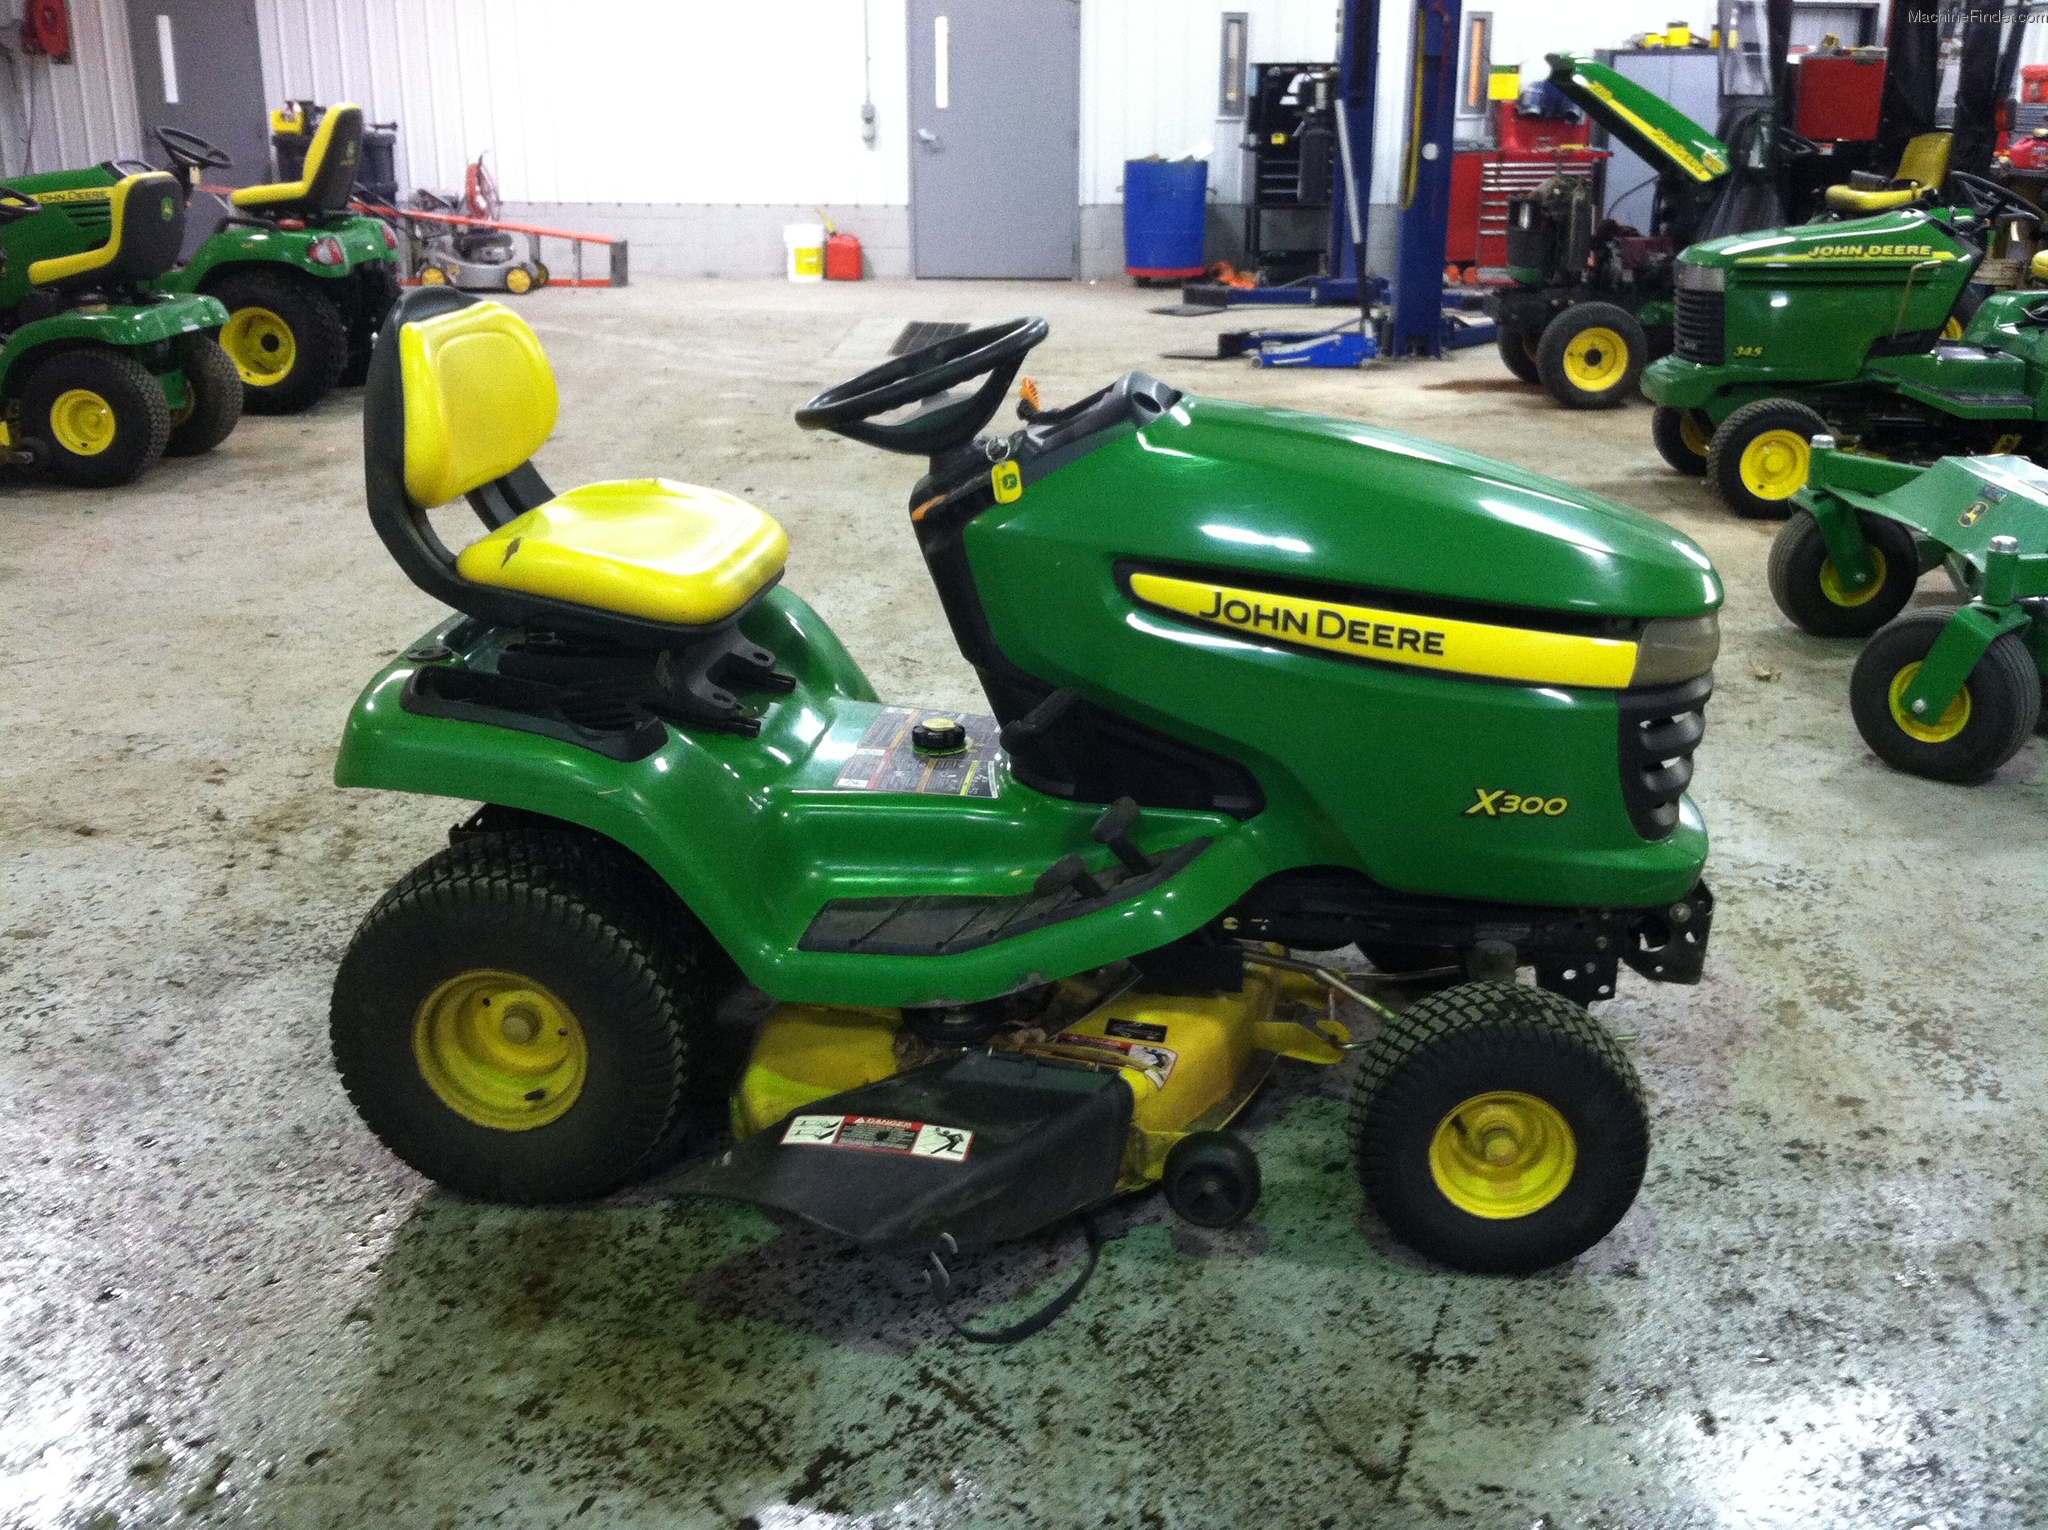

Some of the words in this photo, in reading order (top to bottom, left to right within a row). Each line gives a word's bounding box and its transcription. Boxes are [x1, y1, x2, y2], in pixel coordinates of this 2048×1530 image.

[1808, 245, 1863, 257] JOHN
[1867, 245, 1932, 256] DEERE
[1199, 592, 1308, 635] JOHN
[1315, 608, 1446, 656] DEERE
[1464, 788, 1568, 816] X300
[865, 1117, 912, 1129] DANGER
